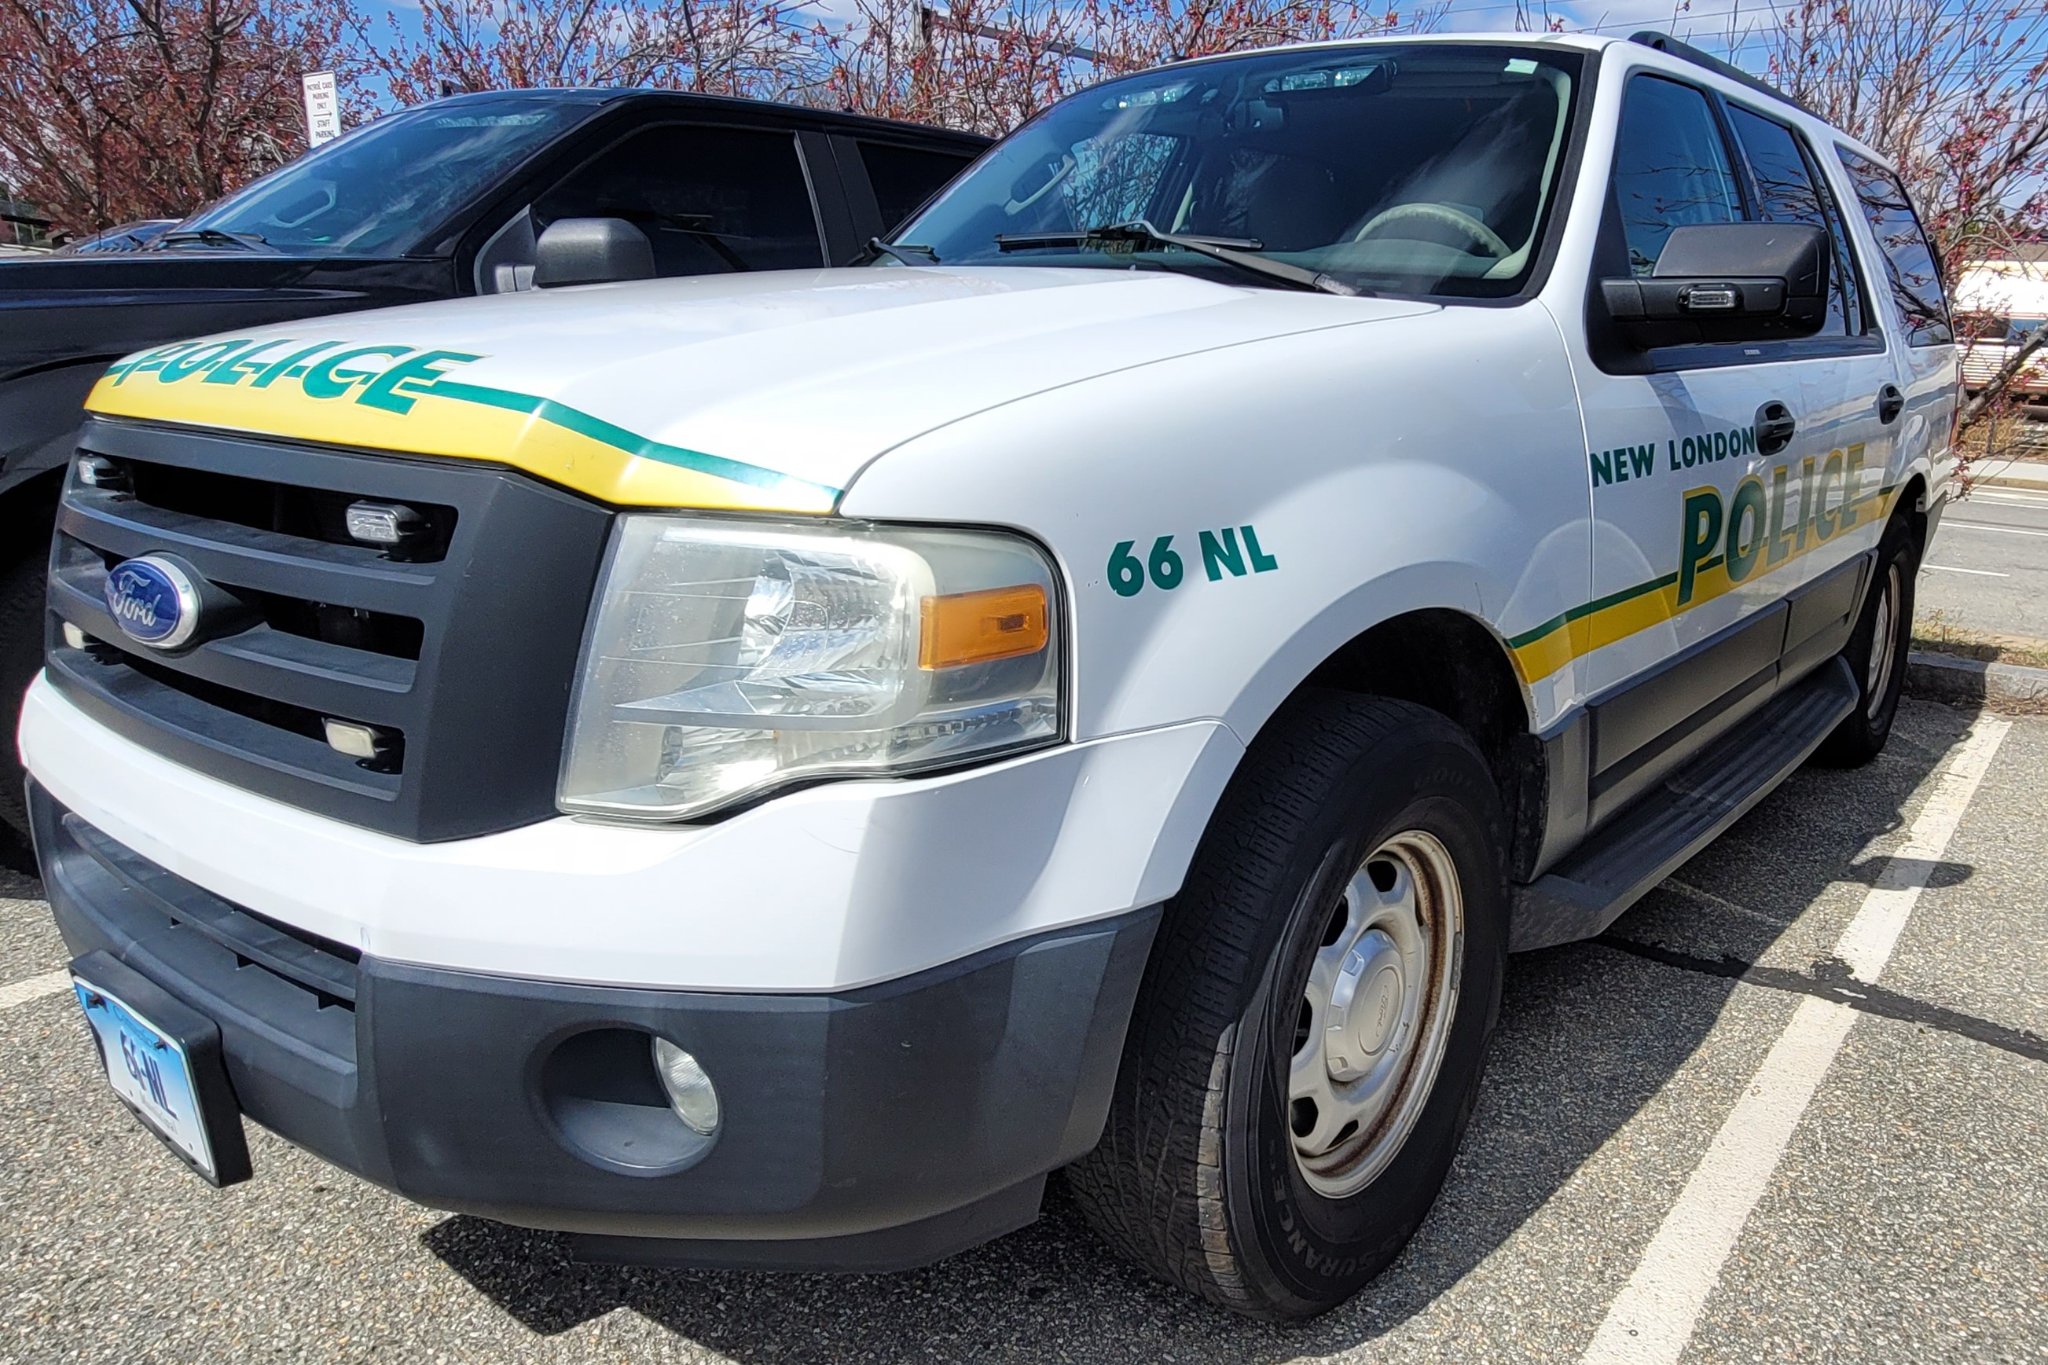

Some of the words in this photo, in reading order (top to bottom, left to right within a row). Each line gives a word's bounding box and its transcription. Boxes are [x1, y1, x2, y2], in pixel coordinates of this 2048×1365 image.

[313, 92, 329, 100] PARKING
[316, 102, 327, 110] ONLY
[316, 119, 331, 128] STAFF
[111, 338, 488, 416] POLICE
[1590, 443, 1656, 488] NEW
[1668, 425, 1756, 471] LONDON
[1677, 441, 1867, 607] POLICE
[1106, 535, 1184, 598] 66
[1198, 524, 1279, 582] NL
[113, 570, 162, 627] Ford
